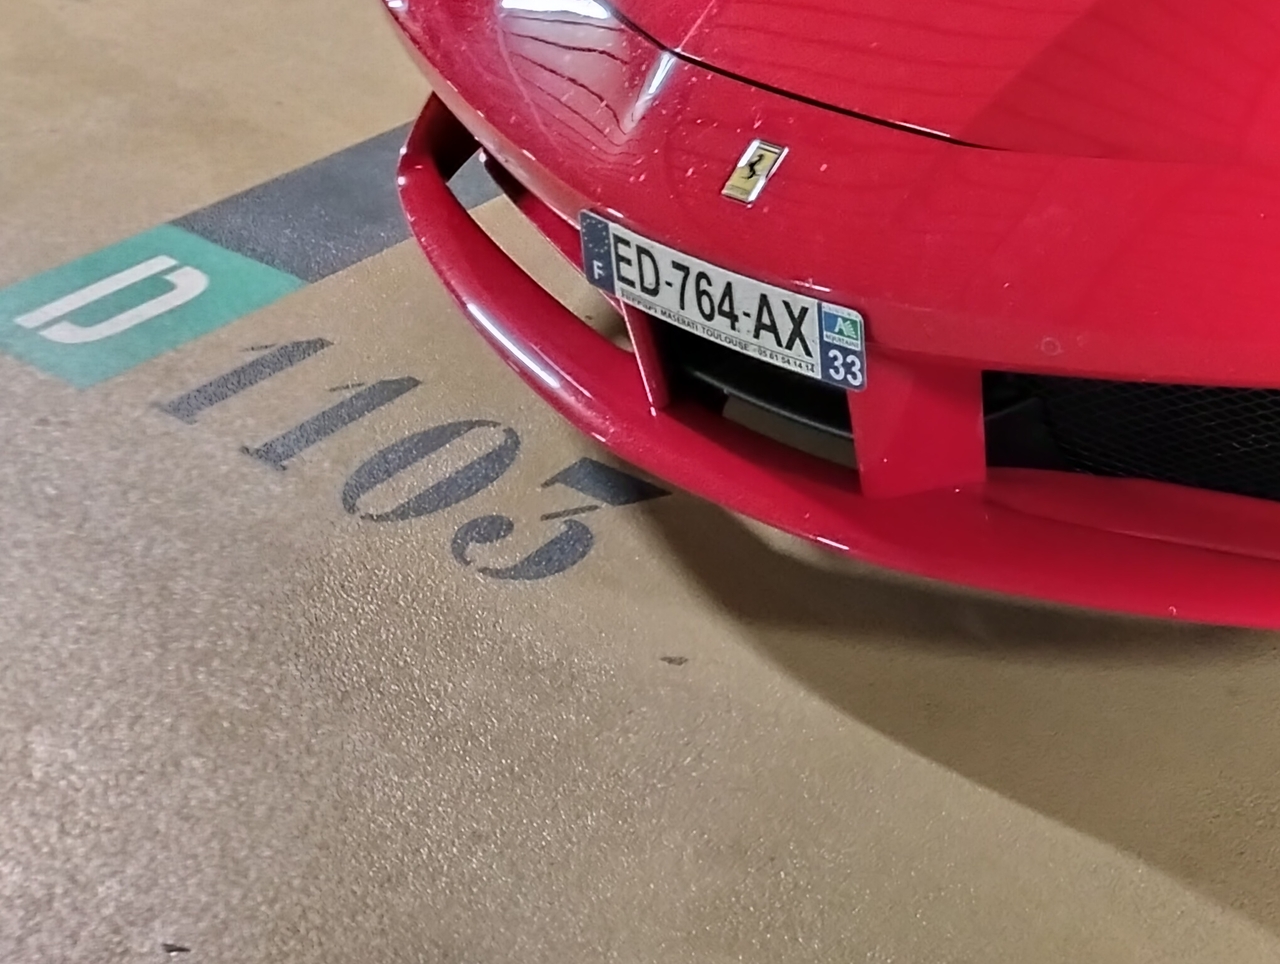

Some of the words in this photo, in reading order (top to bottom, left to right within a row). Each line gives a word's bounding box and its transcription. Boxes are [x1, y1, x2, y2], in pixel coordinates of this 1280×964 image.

[593, 260, 602, 279] F
[13, 254, 210, 344] D
[613, 232, 813, 358] ED-764-AX
[660, 309, 699, 331] MASERATI
[701, 327, 750, 351] TOULOUSE
[828, 349, 863, 386] 33
